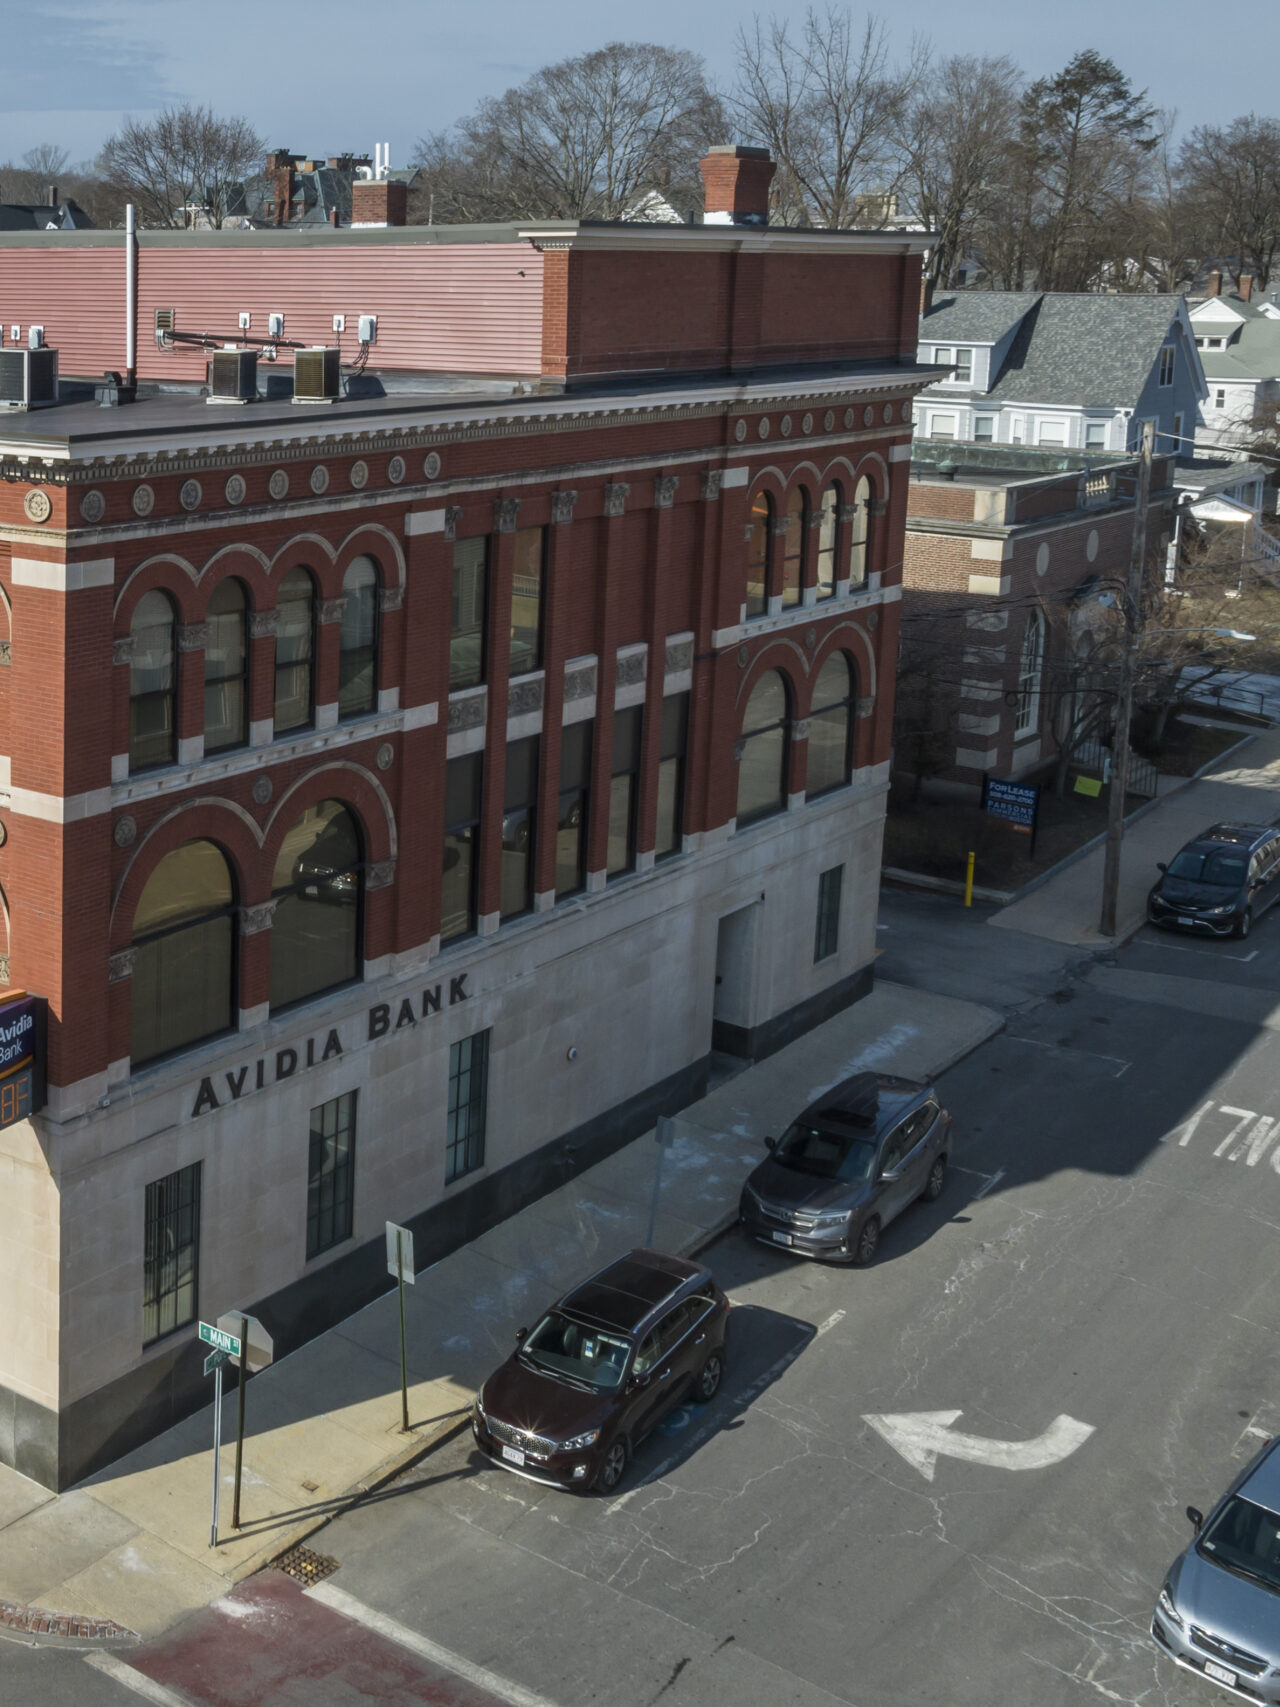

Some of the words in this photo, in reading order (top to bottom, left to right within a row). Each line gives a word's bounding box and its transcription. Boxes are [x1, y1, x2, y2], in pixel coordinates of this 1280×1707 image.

[990, 782, 1007, 792] FOR
[1008, 785, 1035, 798] LEASE
[987, 800, 1033, 815] PARSONS
[191, 1028, 344, 1118] AVIDIA
[368, 973, 469, 1042] BANK
[210, 1329, 231, 1349] MAIN
